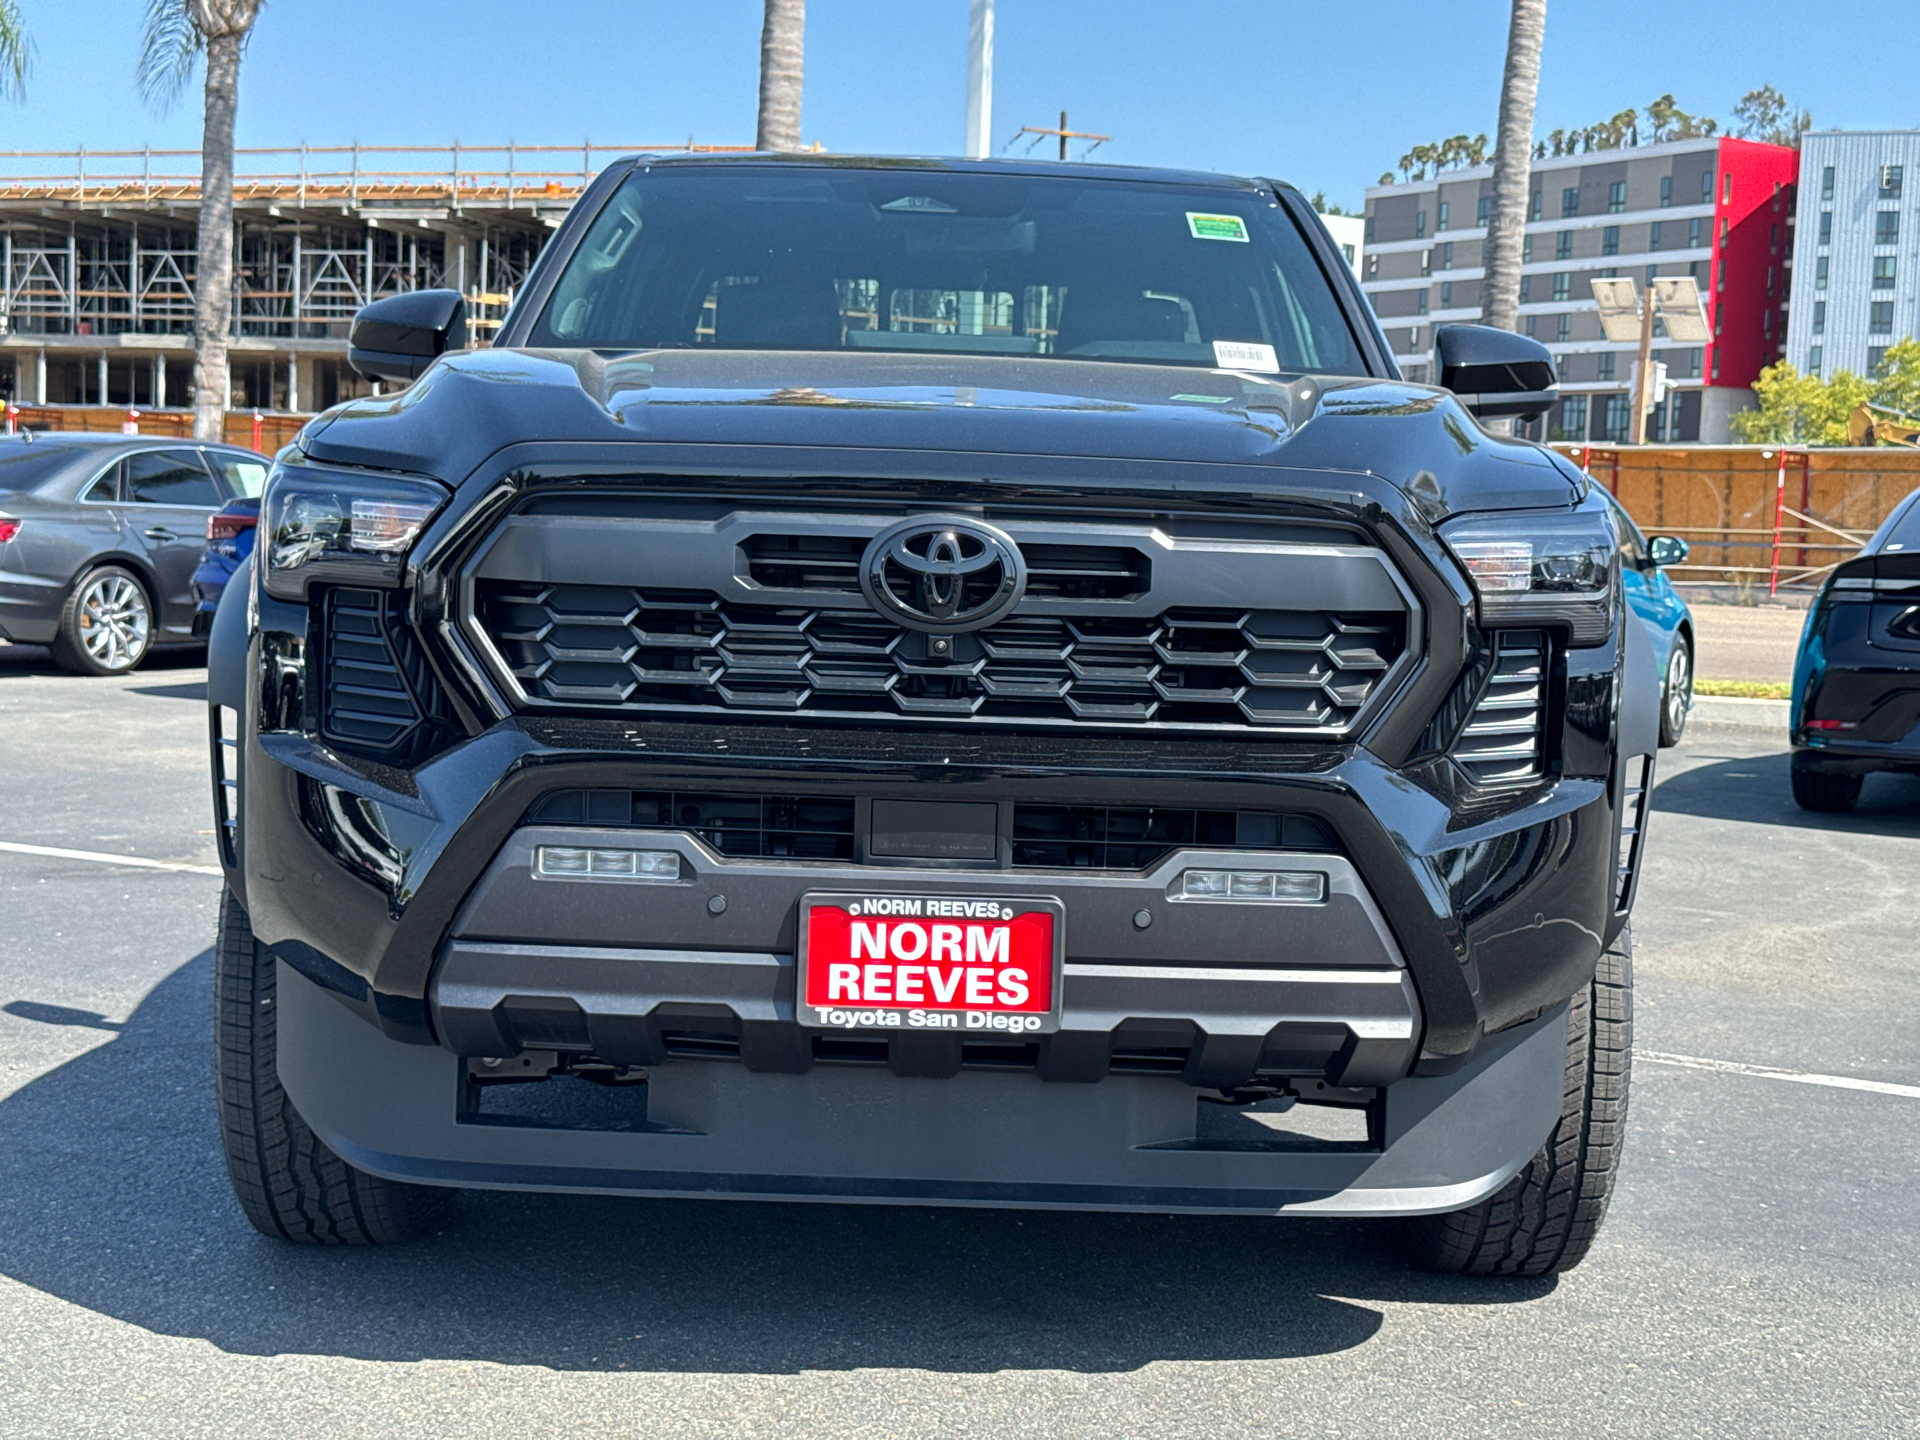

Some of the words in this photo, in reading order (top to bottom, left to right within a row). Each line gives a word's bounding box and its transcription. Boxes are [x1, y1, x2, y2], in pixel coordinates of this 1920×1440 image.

[863, 899, 922, 916] NORM
[927, 901, 1000, 918] REEVES
[850, 922, 1010, 963] NORM
[828, 963, 1030, 1006] REEVES
[815, 1007, 901, 1029] Toyota
[907, 1009, 958, 1028] San
[966, 1011, 1042, 1033] Diego
